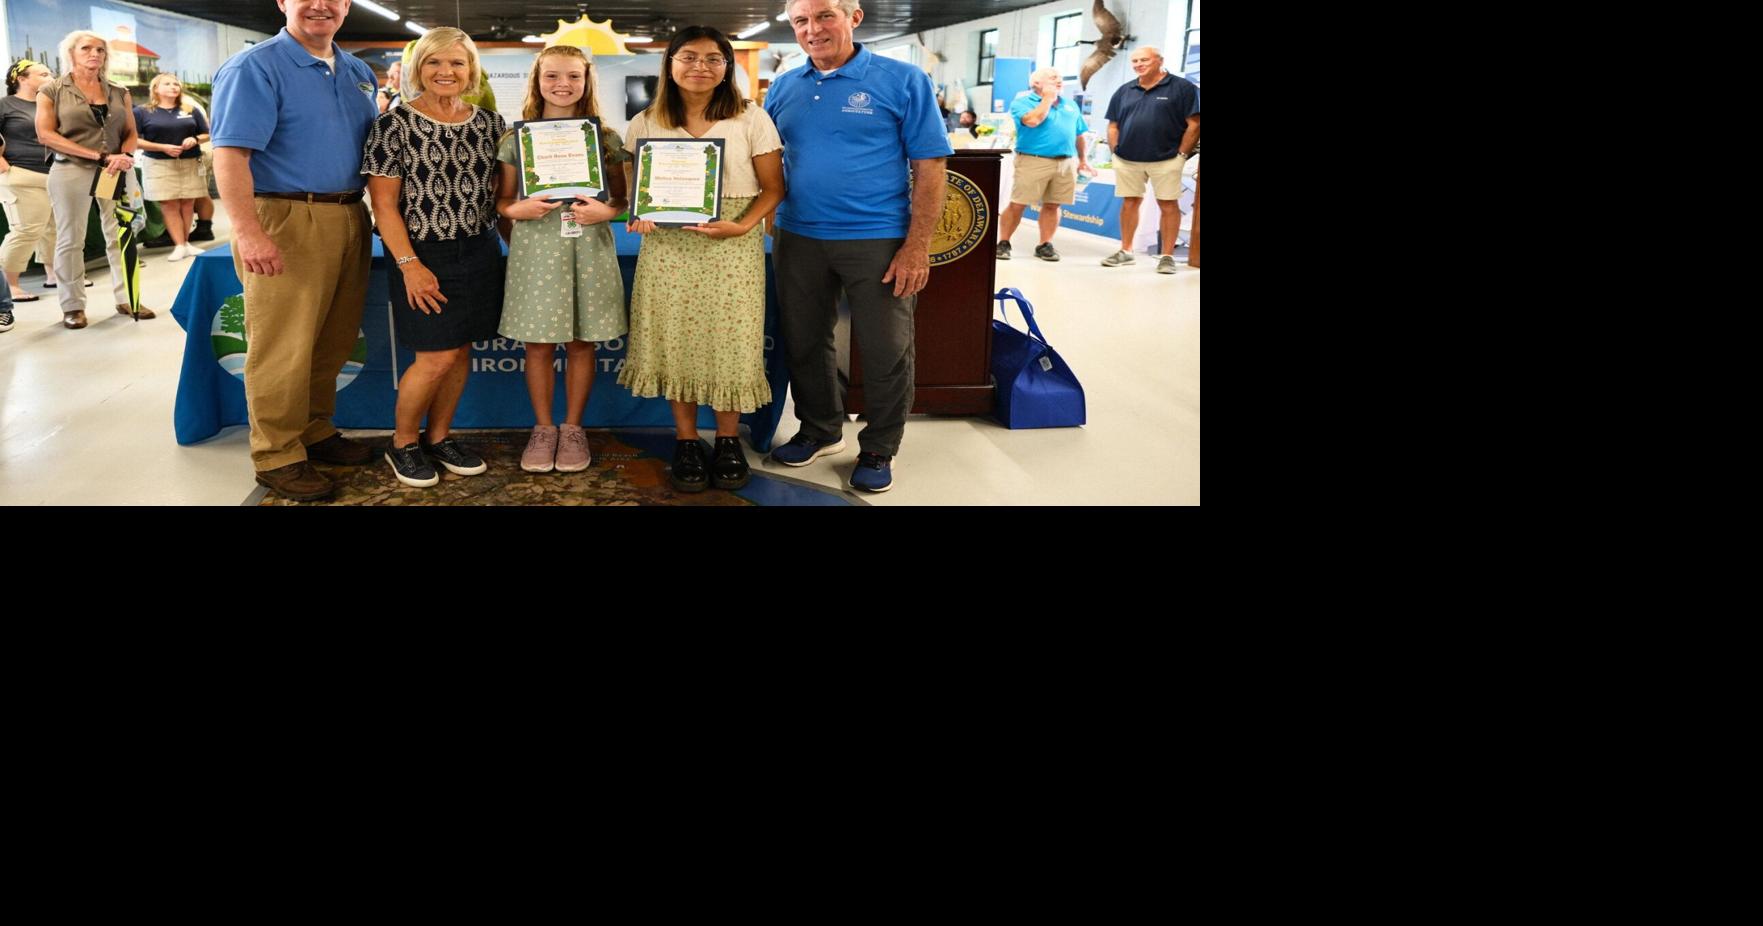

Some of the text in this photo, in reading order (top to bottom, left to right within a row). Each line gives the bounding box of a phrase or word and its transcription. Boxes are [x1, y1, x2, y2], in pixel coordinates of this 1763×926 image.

[963, 185, 977, 196] OF
[965, 196, 986, 246] DELAWARE
[1062, 208, 1104, 227] Stewardship
